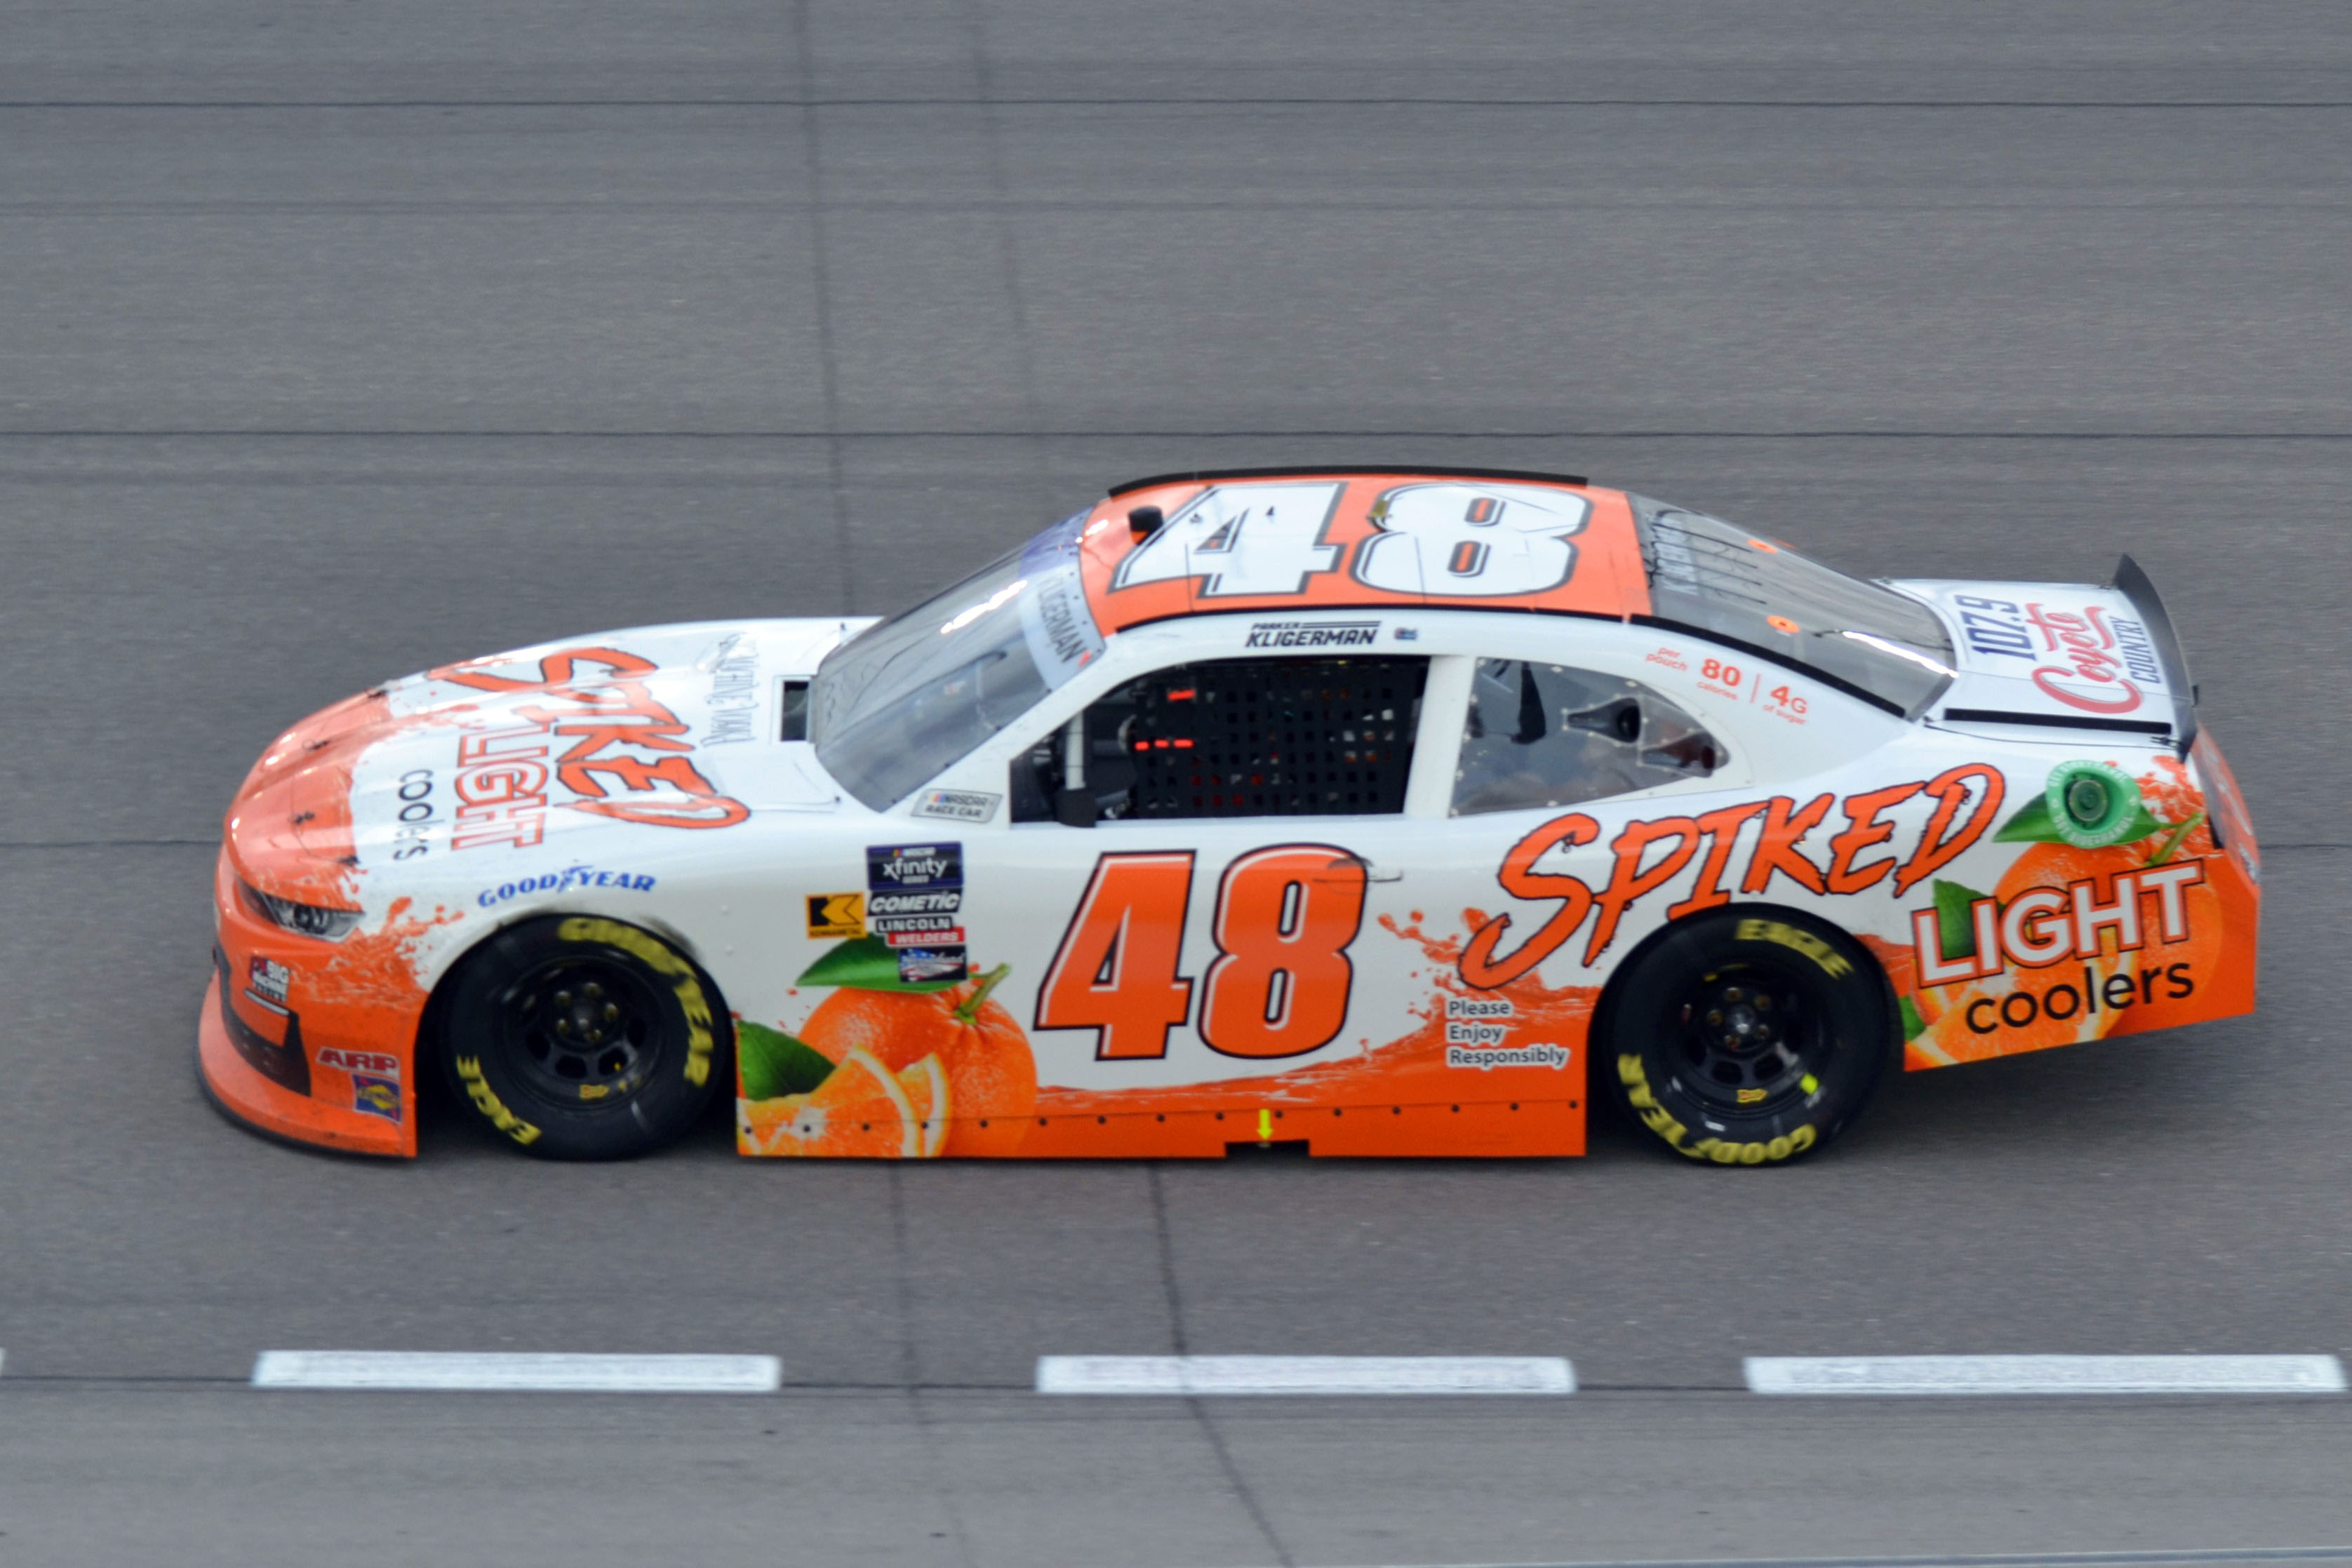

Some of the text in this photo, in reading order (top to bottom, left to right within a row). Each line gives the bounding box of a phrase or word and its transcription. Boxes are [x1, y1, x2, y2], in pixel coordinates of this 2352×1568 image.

[1107, 481, 1592, 598] 48
[1245, 629, 1377, 648] KLIGERMAN
[1955, 594, 2036, 661] 107.9
[1645, 653, 1688, 671] pouch
[1657, 647, 1681, 658] per
[2025, 603, 2144, 714] Coyote
[2109, 615, 2161, 684] COUNTRY
[1701, 657, 1742, 687] 80
[1770, 685, 1808, 714] 4G
[425, 647, 751, 829] SPIKED
[450, 723, 549, 851] LIGHT
[883, 857, 947, 881] xfinity
[1458, 763, 2005, 990] SPIKED
[477, 865, 657, 907] GOODYEAR
[878, 918, 951, 932] LINCOLN
[895, 932, 959, 945] WELDERS
[1911, 858, 2205, 989] LIGHT
[1033, 842, 1368, 1061] 48
[1449, 1000, 1510, 1015] Please
[1966, 962, 2194, 1034] coolers
[1449, 1024, 1503, 1043] Enjoy
[320, 1050, 396, 1071] ARP
[1450, 1046, 1566, 1067] Responsibly
